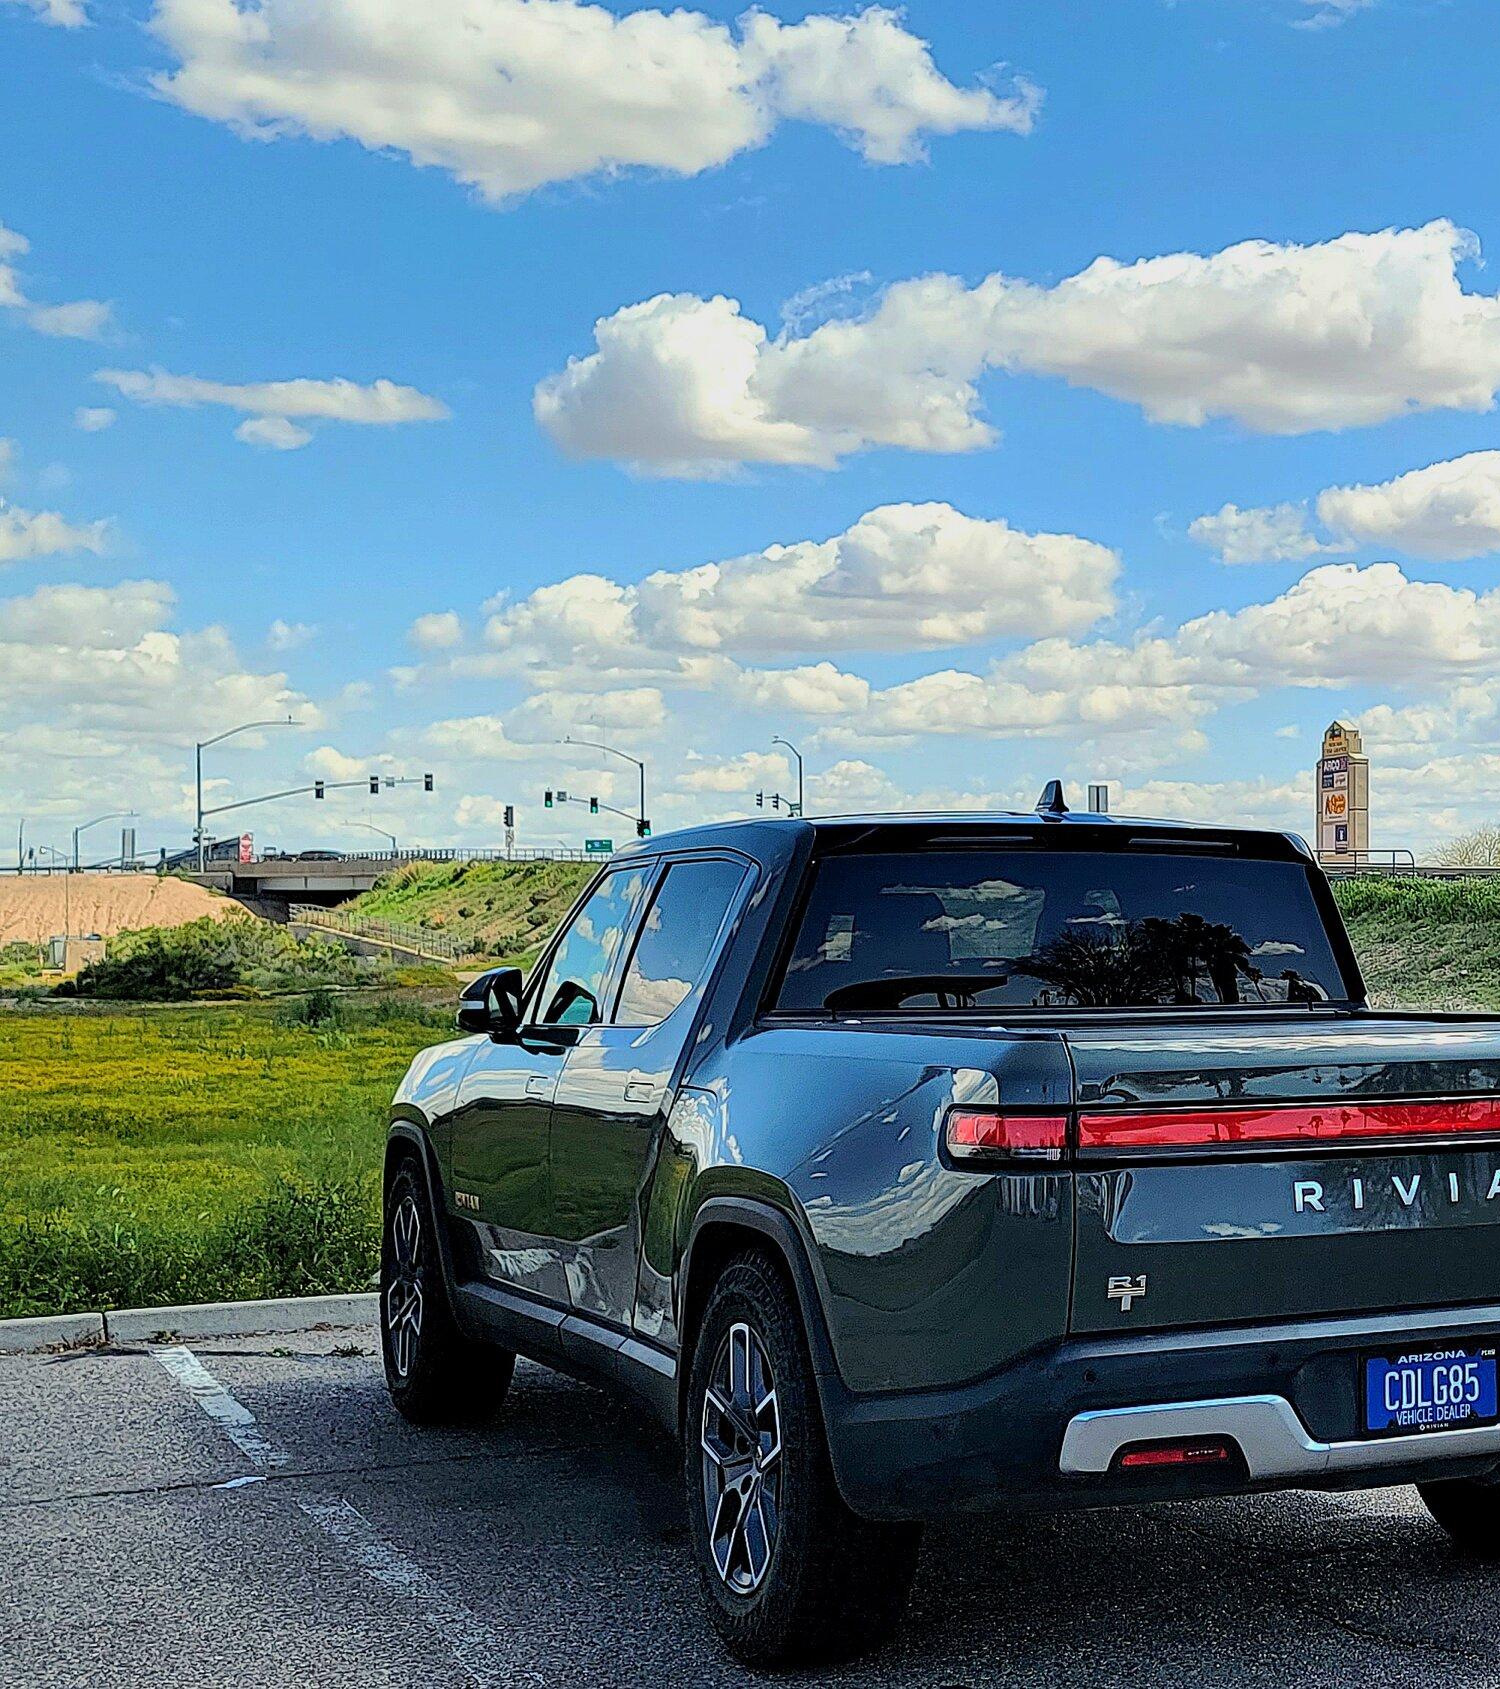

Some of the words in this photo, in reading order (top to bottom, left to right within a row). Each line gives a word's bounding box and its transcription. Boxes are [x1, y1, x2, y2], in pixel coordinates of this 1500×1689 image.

[1397, 1350, 1466, 1364] ARIZONA
[1385, 1363, 1479, 1410] CDLG85
[1396, 1407, 1433, 1425] VEHICLE
[1437, 1404, 1470, 1421] DEALER
